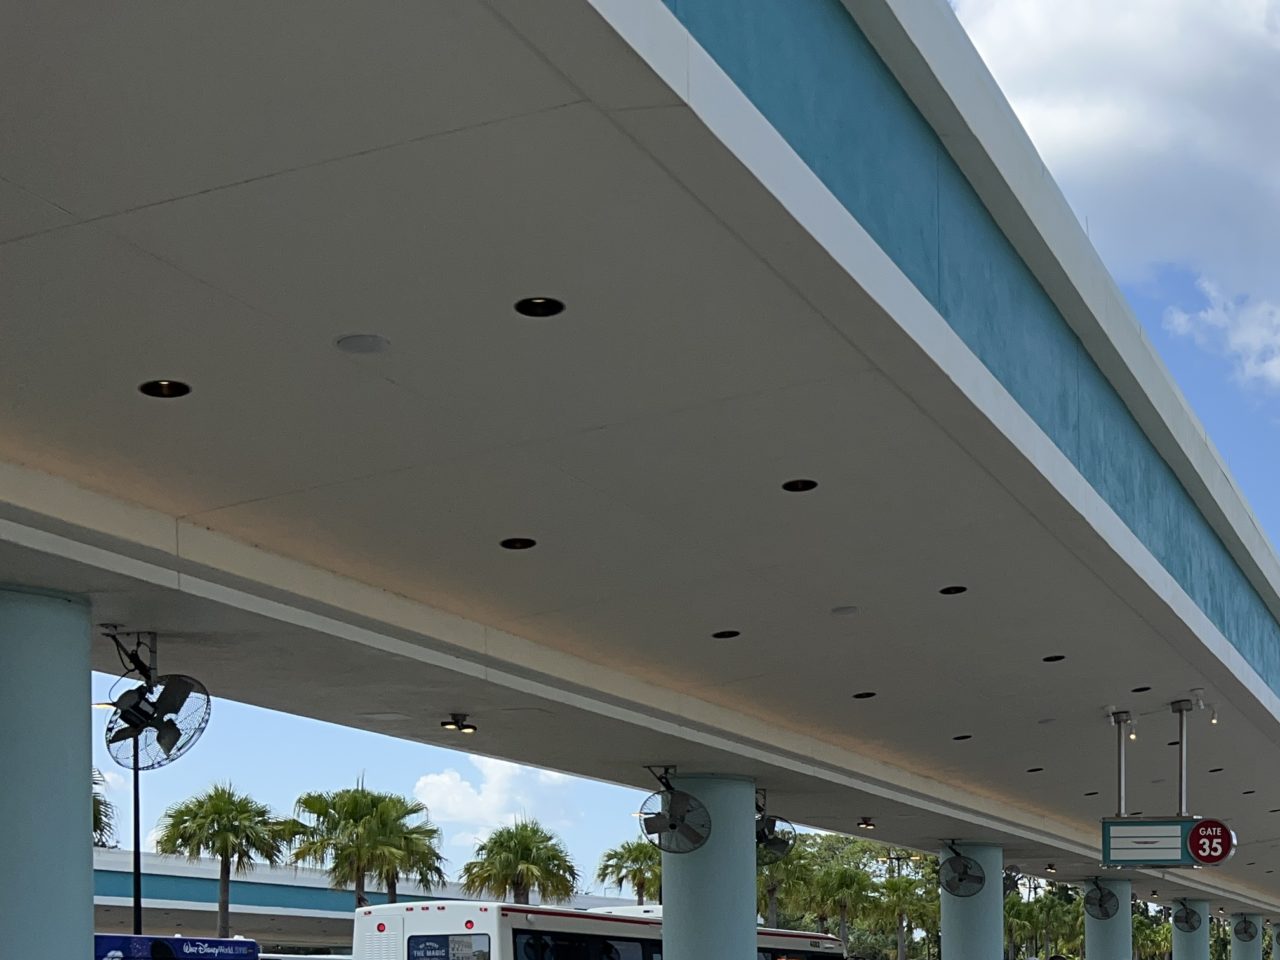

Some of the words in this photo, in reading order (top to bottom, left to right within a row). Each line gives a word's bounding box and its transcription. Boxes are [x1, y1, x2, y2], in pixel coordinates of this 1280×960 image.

[1199, 827, 1222, 836] GATE
[1198, 838, 1222, 856] 35
[196, 941, 219, 957] Disney
[426, 949, 446, 957] MAGIC
